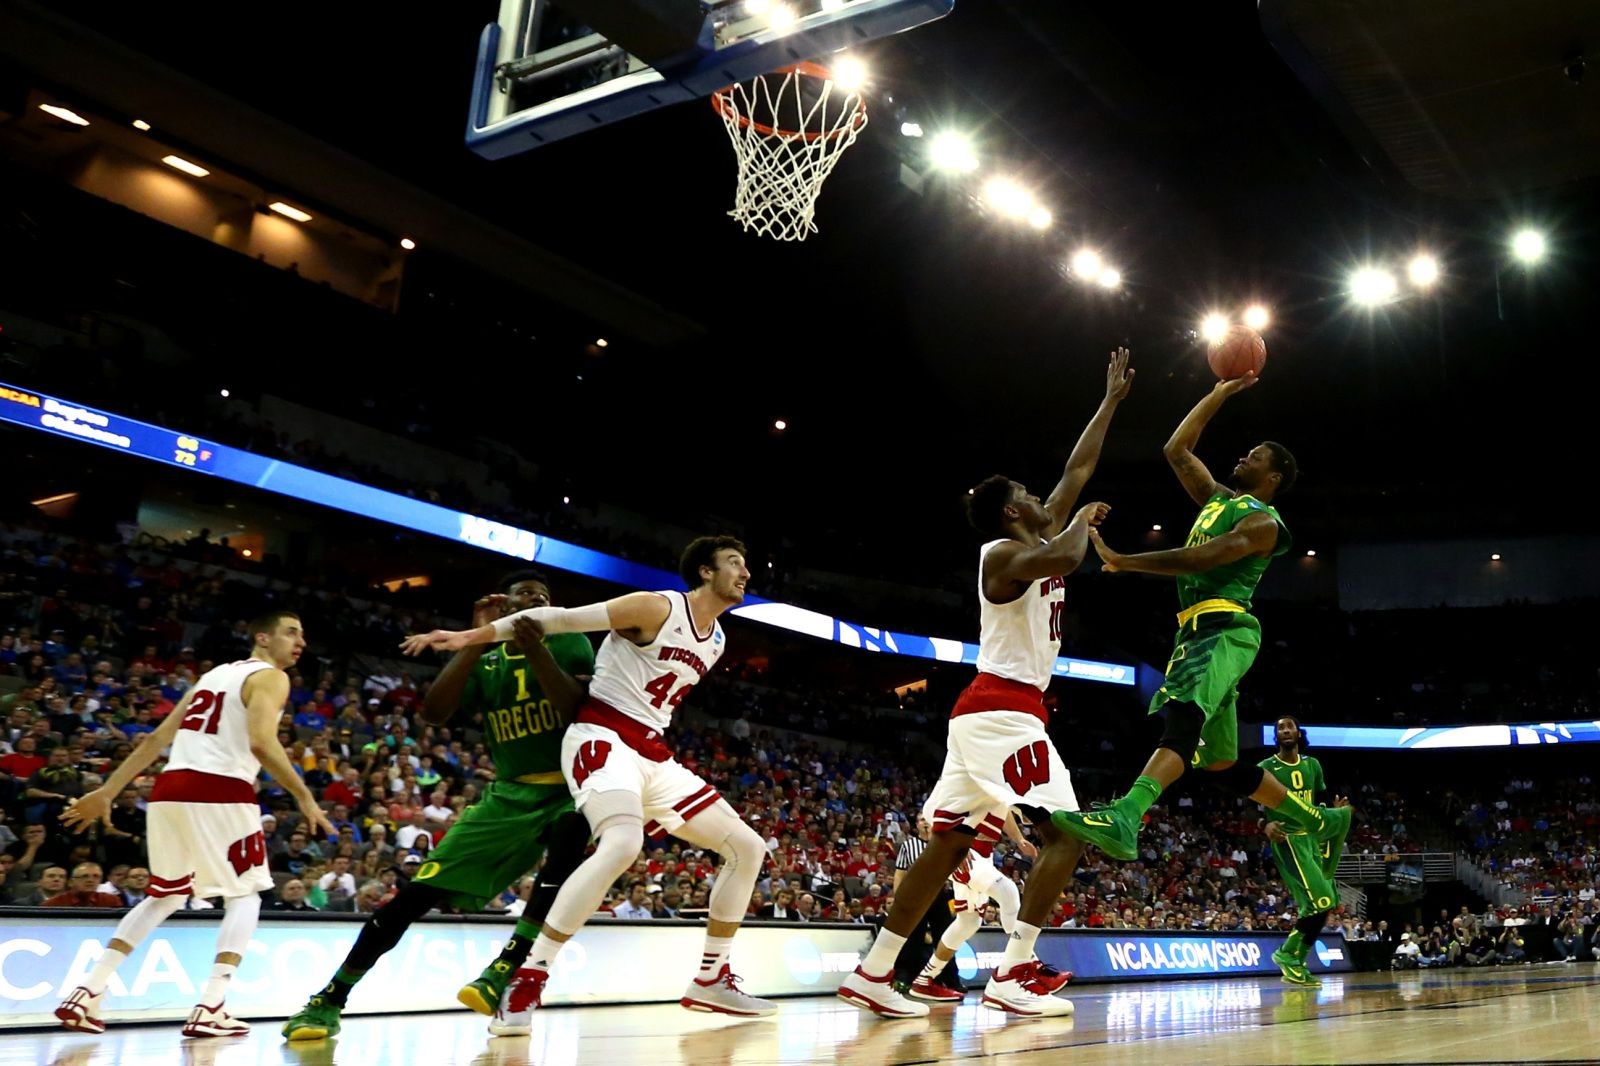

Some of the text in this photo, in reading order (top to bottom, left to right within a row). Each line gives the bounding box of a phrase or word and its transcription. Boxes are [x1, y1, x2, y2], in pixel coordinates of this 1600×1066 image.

[514, 669, 530, 701] 1
[180, 690, 225, 734] 21
[1291, 770, 1304, 789] 0
[1106, 940, 1261, 971] NCAA.COM/SHOP
